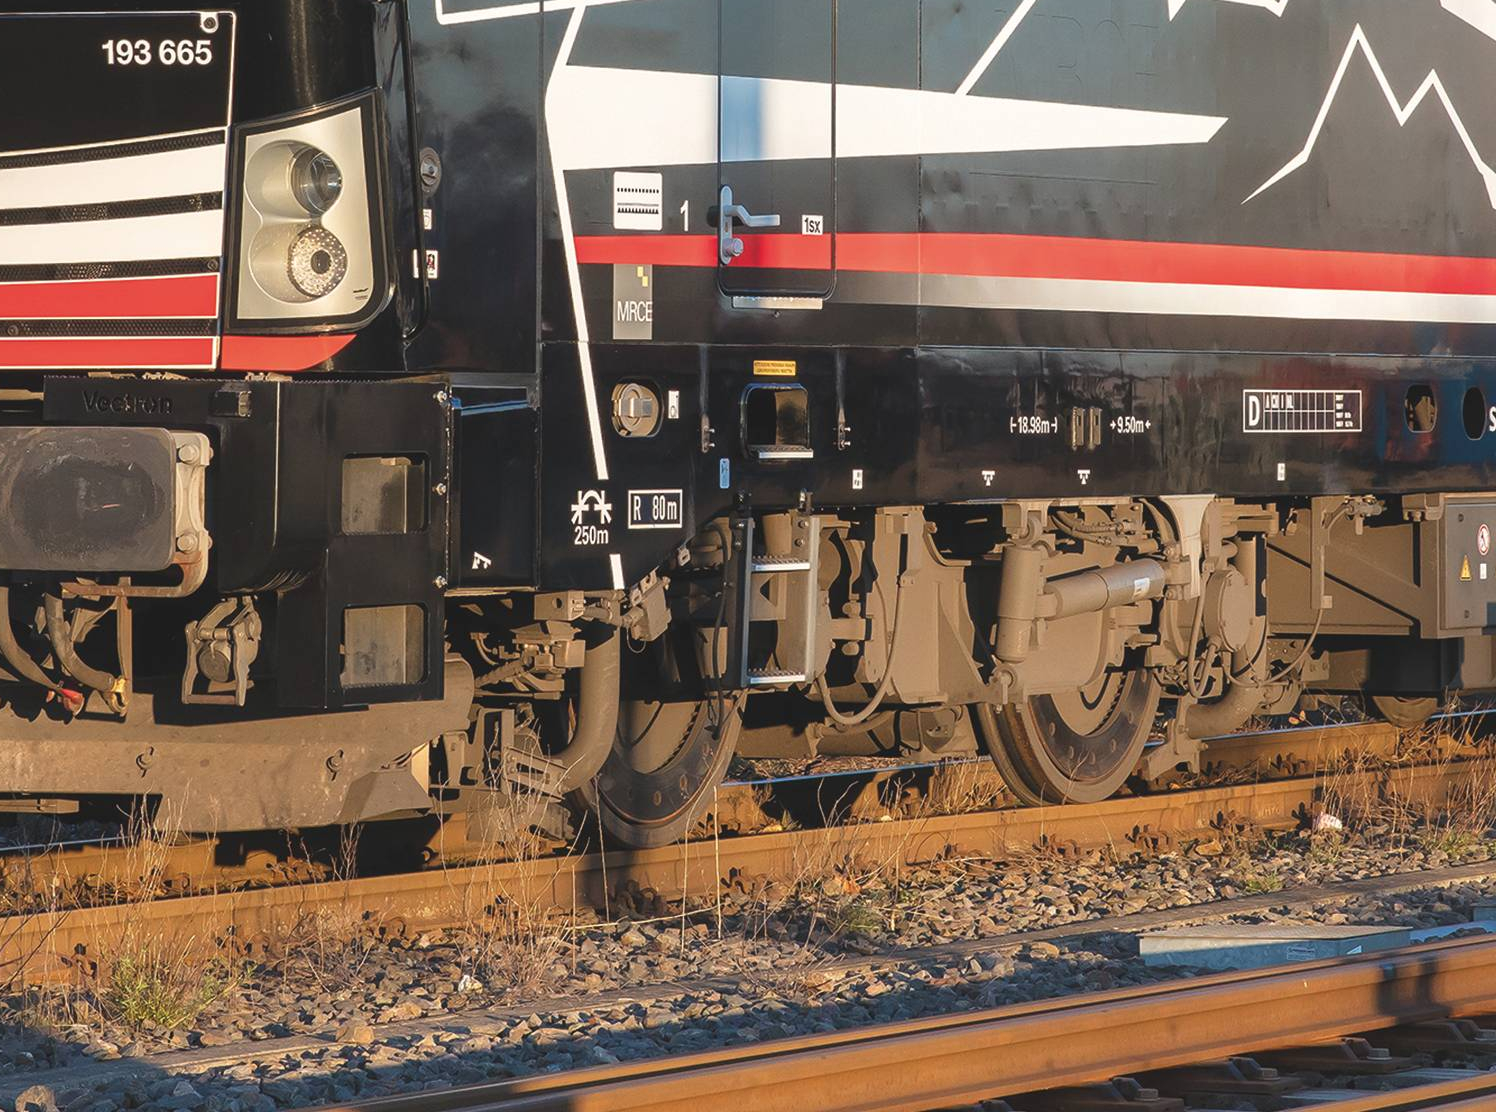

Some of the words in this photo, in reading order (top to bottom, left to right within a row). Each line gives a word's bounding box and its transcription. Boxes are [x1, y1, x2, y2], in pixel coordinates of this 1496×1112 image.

[101, 39, 150, 66] 193
[158, 39, 213, 65] 665
[680, 200, 689, 231] 1
[617, 301, 652, 321] MRCE
[82, 390, 175, 414] Vectron
[1248, 395, 1260, 426] D
[1117, 416, 1144, 433] 9.50m
[633, 495, 642, 521] R
[574, 525, 609, 545] 250m
